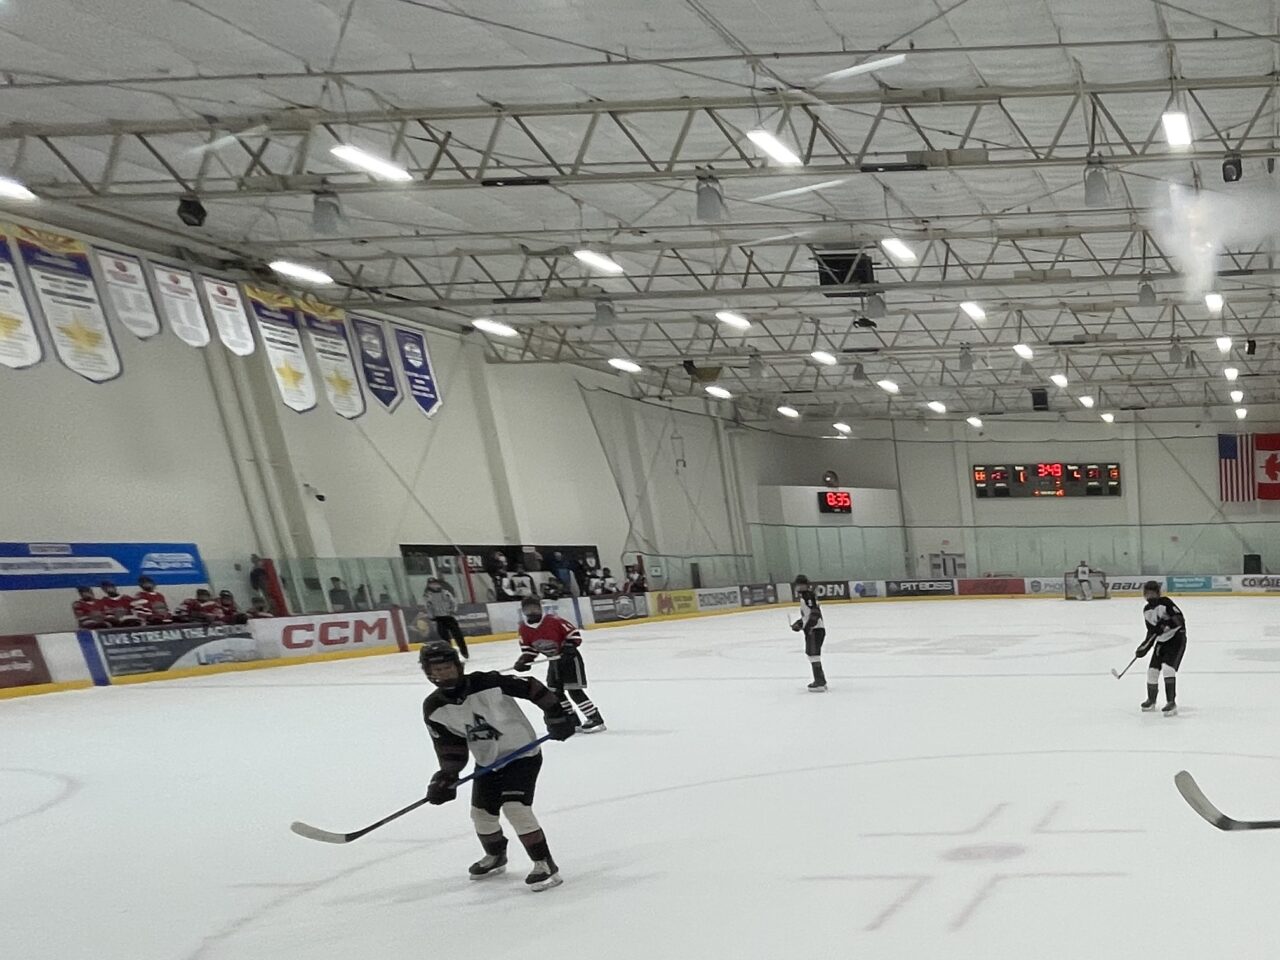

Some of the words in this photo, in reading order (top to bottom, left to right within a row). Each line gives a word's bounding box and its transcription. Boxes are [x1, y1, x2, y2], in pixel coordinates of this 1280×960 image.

[900, 581, 919, 591] PIT
[919, 581, 952, 591] BOSS
[102, 632, 130, 646] LIVE
[130, 628, 183, 644] STREAM
[182, 626, 207, 640] THE
[282, 617, 388, 650] CCM
